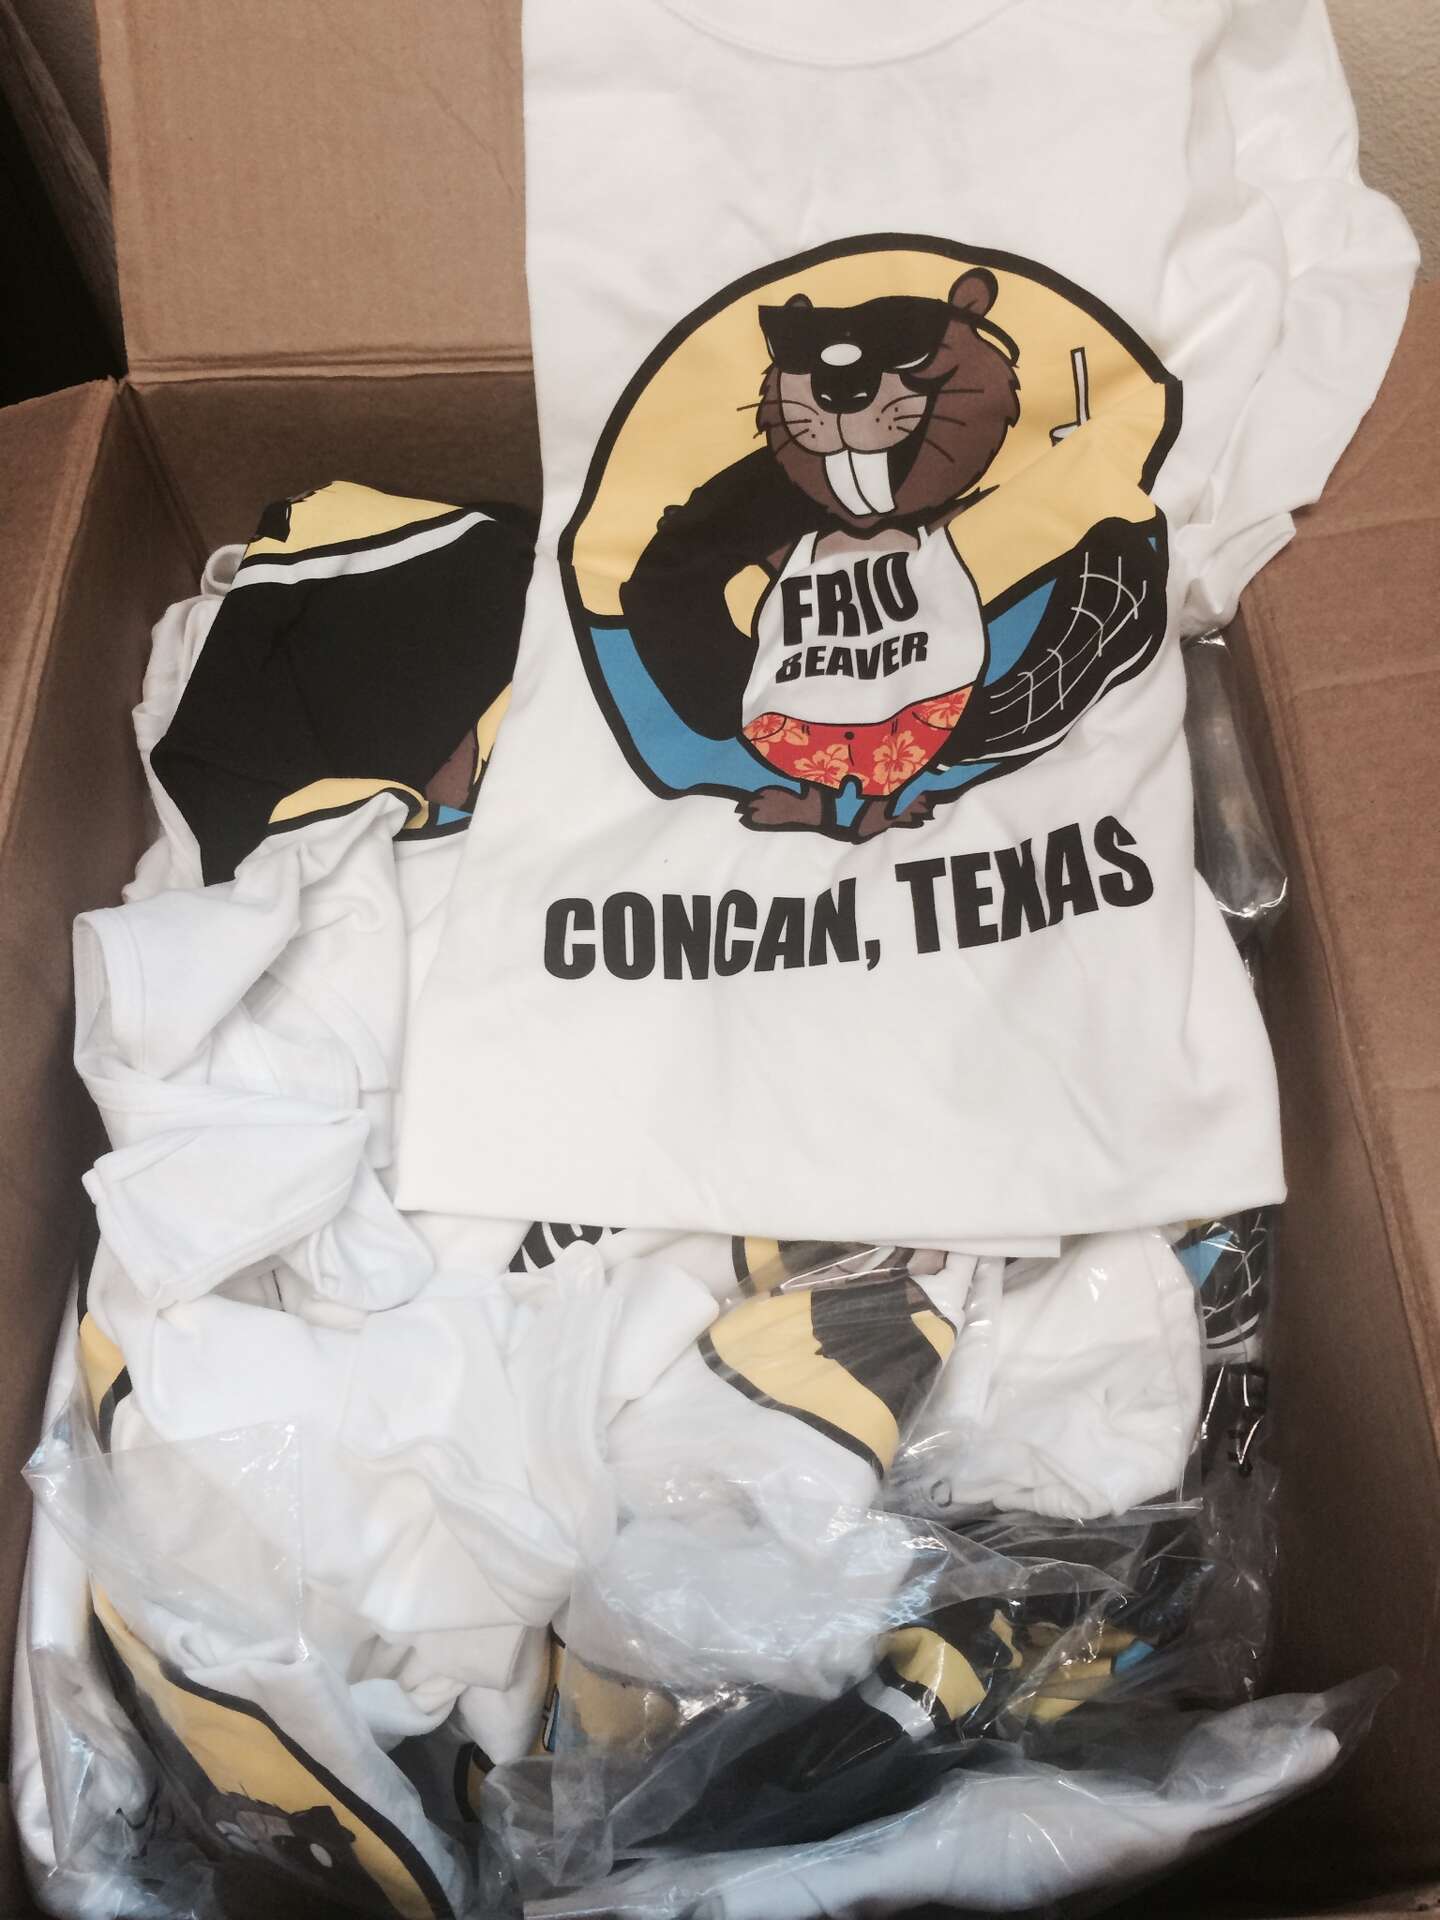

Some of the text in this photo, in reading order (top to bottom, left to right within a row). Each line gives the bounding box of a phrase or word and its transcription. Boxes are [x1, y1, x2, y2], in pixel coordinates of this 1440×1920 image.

[780, 551, 919, 646] FRIO
[775, 632, 928, 684] BEAVER
[544, 815, 1154, 980] CONCAN, TEXAS
